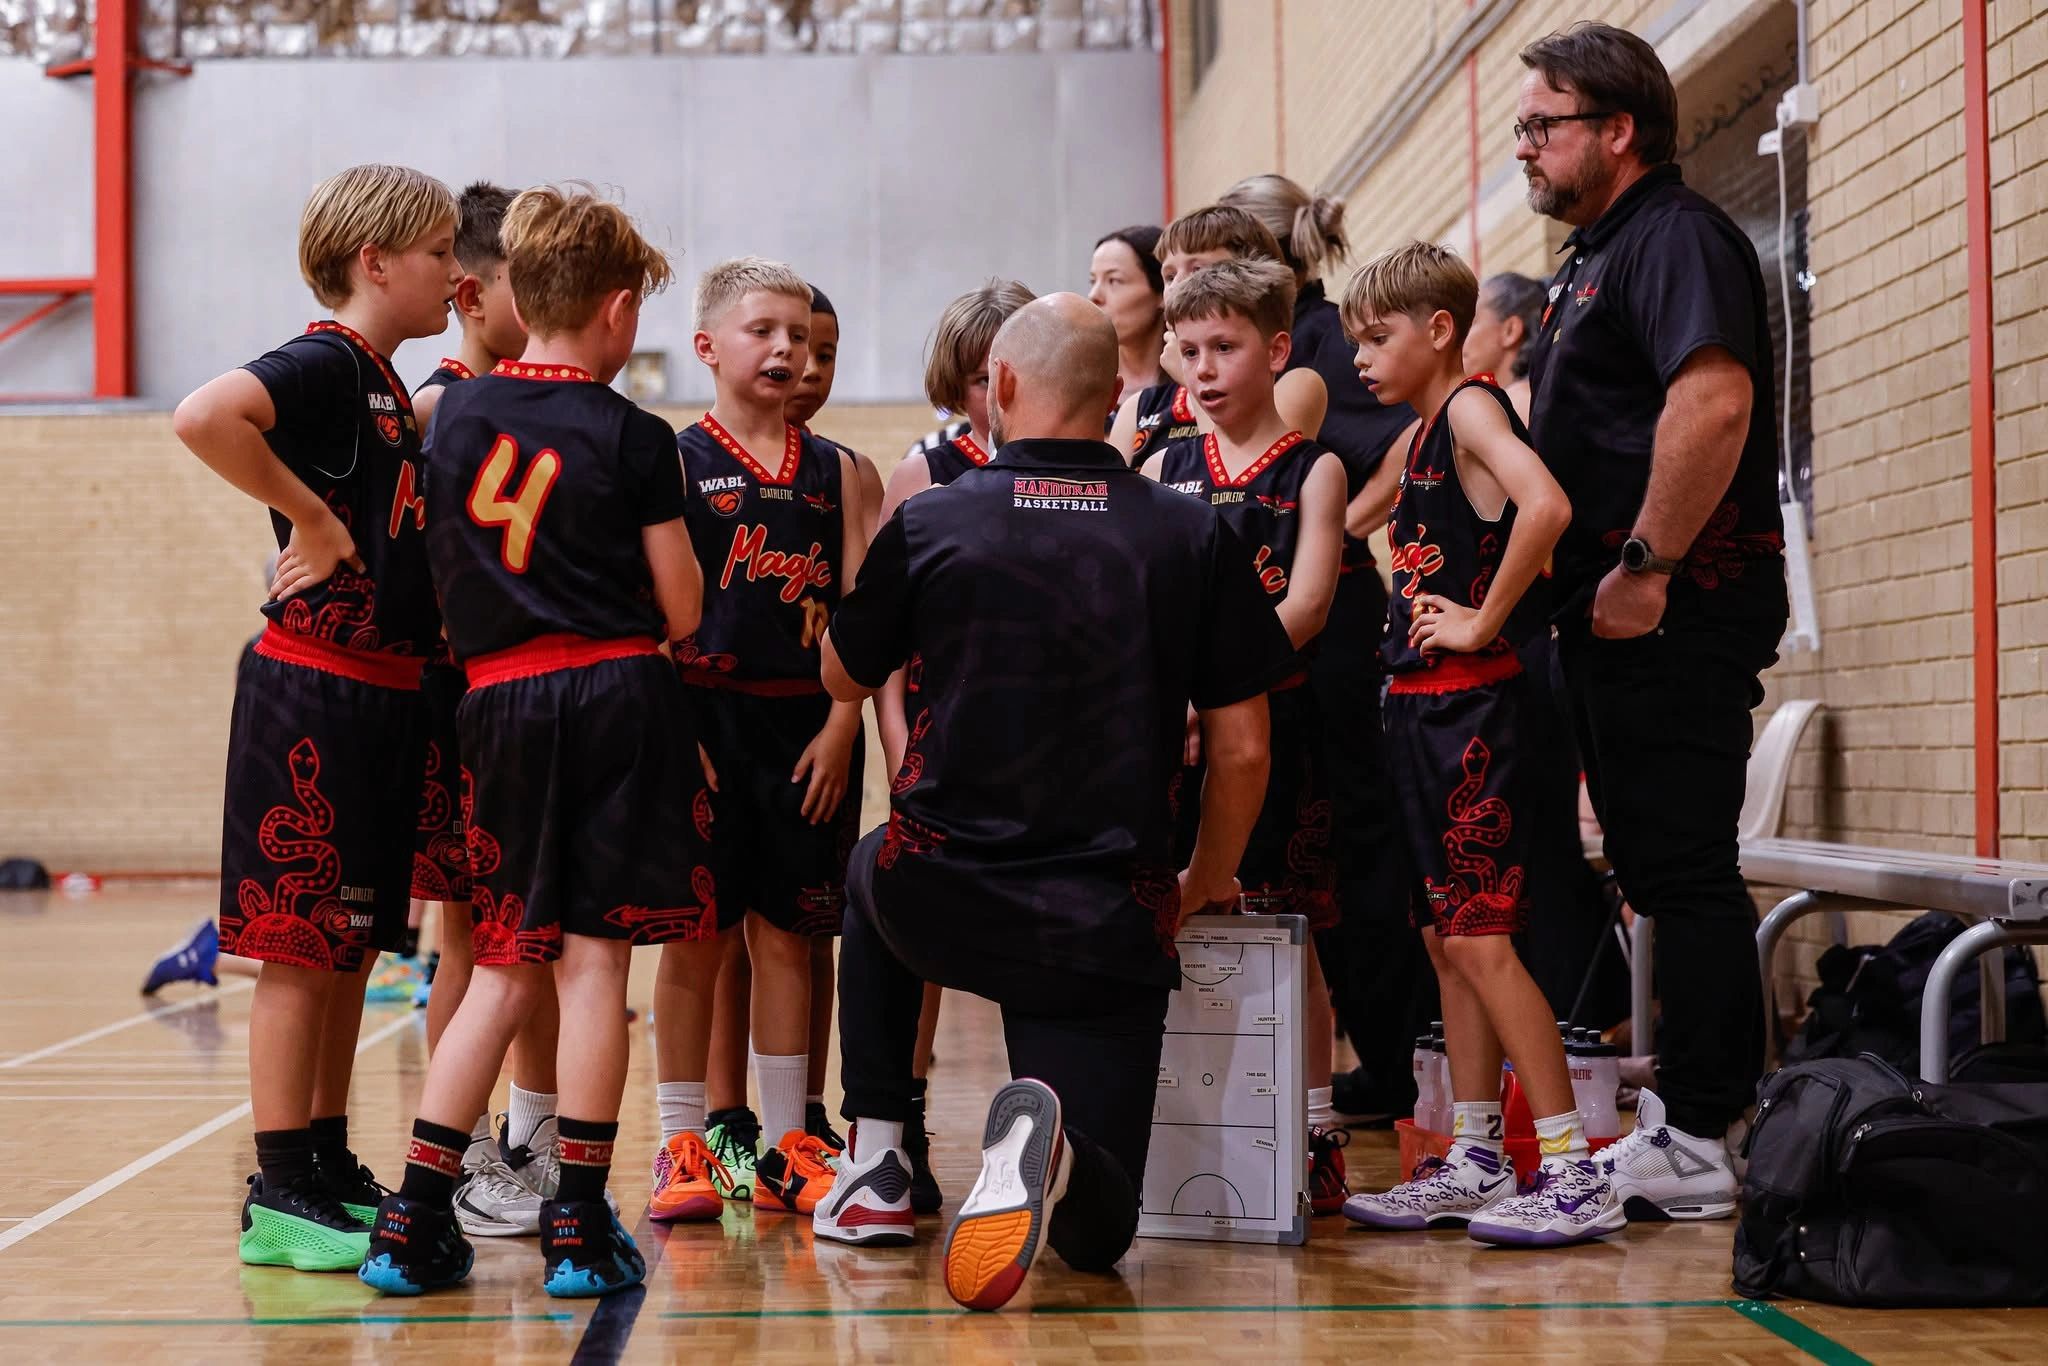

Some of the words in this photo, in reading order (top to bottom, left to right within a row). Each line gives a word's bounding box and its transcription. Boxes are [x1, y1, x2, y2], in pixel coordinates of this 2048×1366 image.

[699, 476, 746, 493] WABL
[1013, 480, 1108, 496] MANDURAH
[766, 488, 793, 501] ATHLETIC
[1219, 491, 1246, 504] ATHLETIC
[466, 433, 562, 574] 4
[1013, 498, 1108, 511] BASKETBALL
[719, 523, 833, 603] Magic
